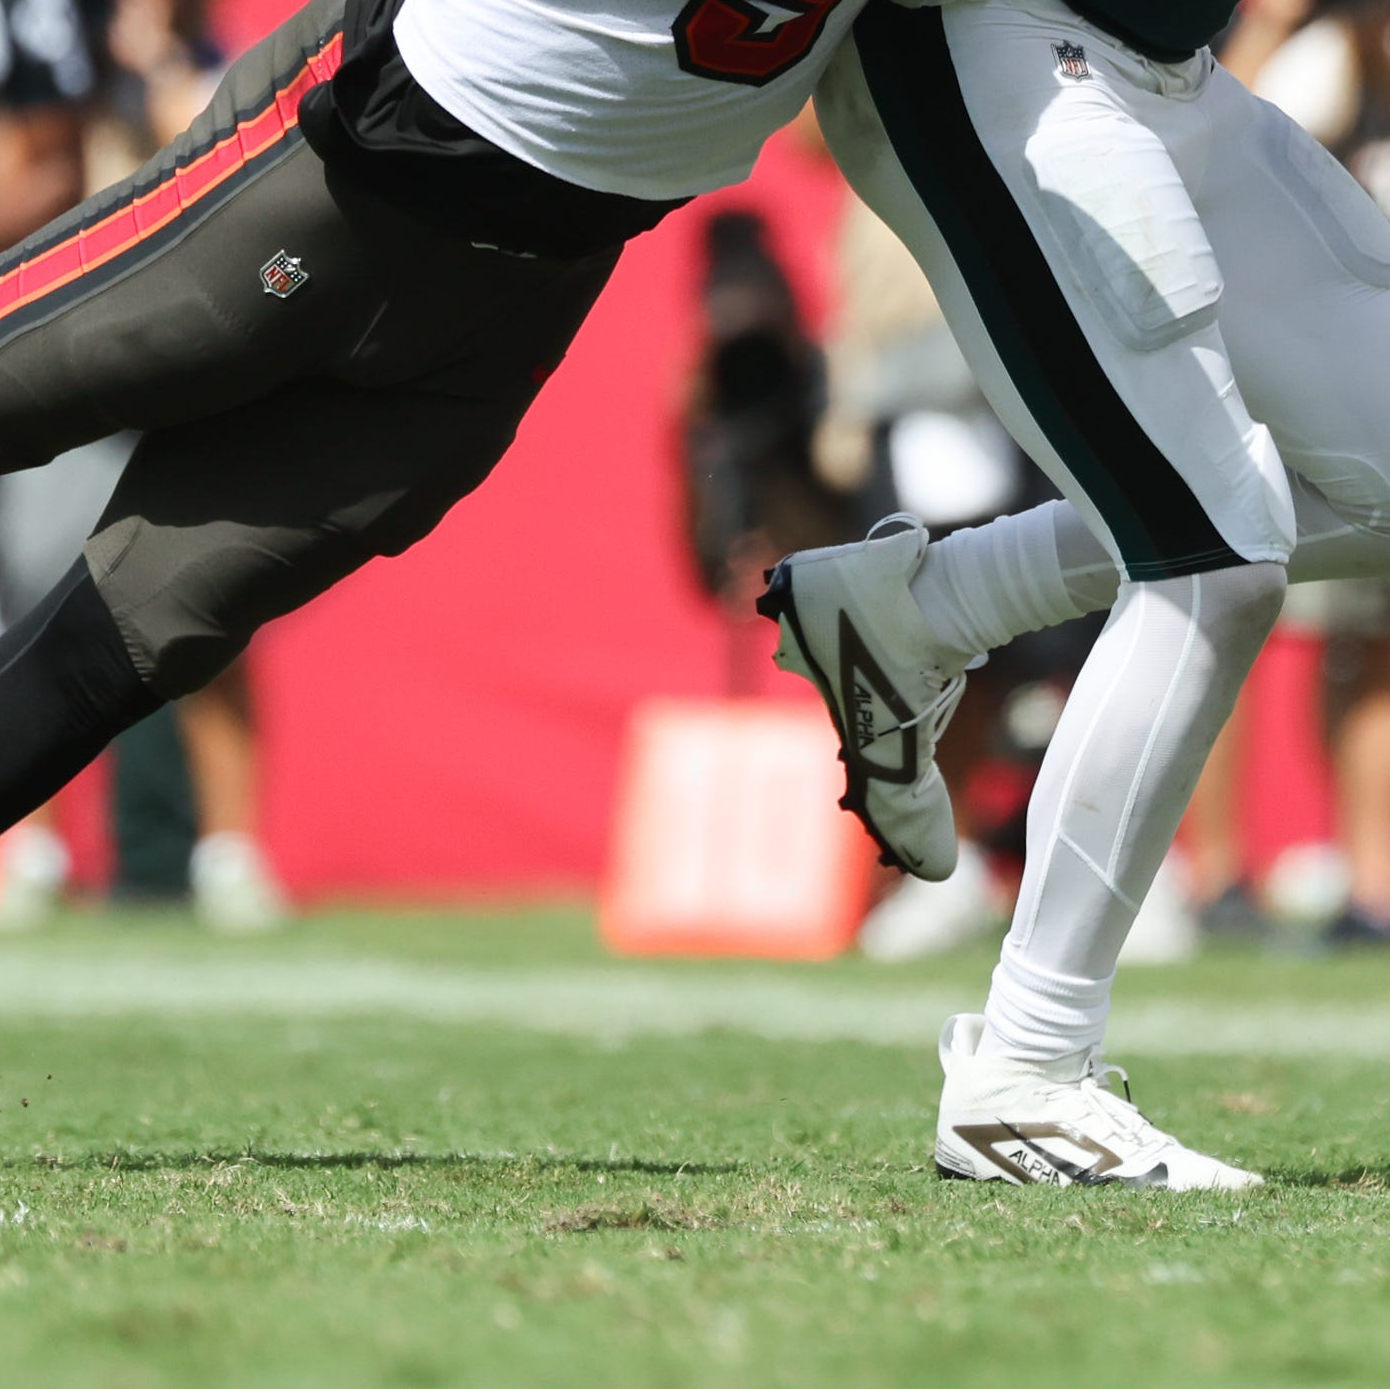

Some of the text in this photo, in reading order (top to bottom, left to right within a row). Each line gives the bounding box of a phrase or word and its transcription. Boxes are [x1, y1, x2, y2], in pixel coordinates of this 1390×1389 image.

[1064, 58, 1088, 76] NFL
[266, 266, 293, 292] NFL
[853, 682, 876, 751] ALPHA
[1009, 1149, 1062, 1186] ALPHA
